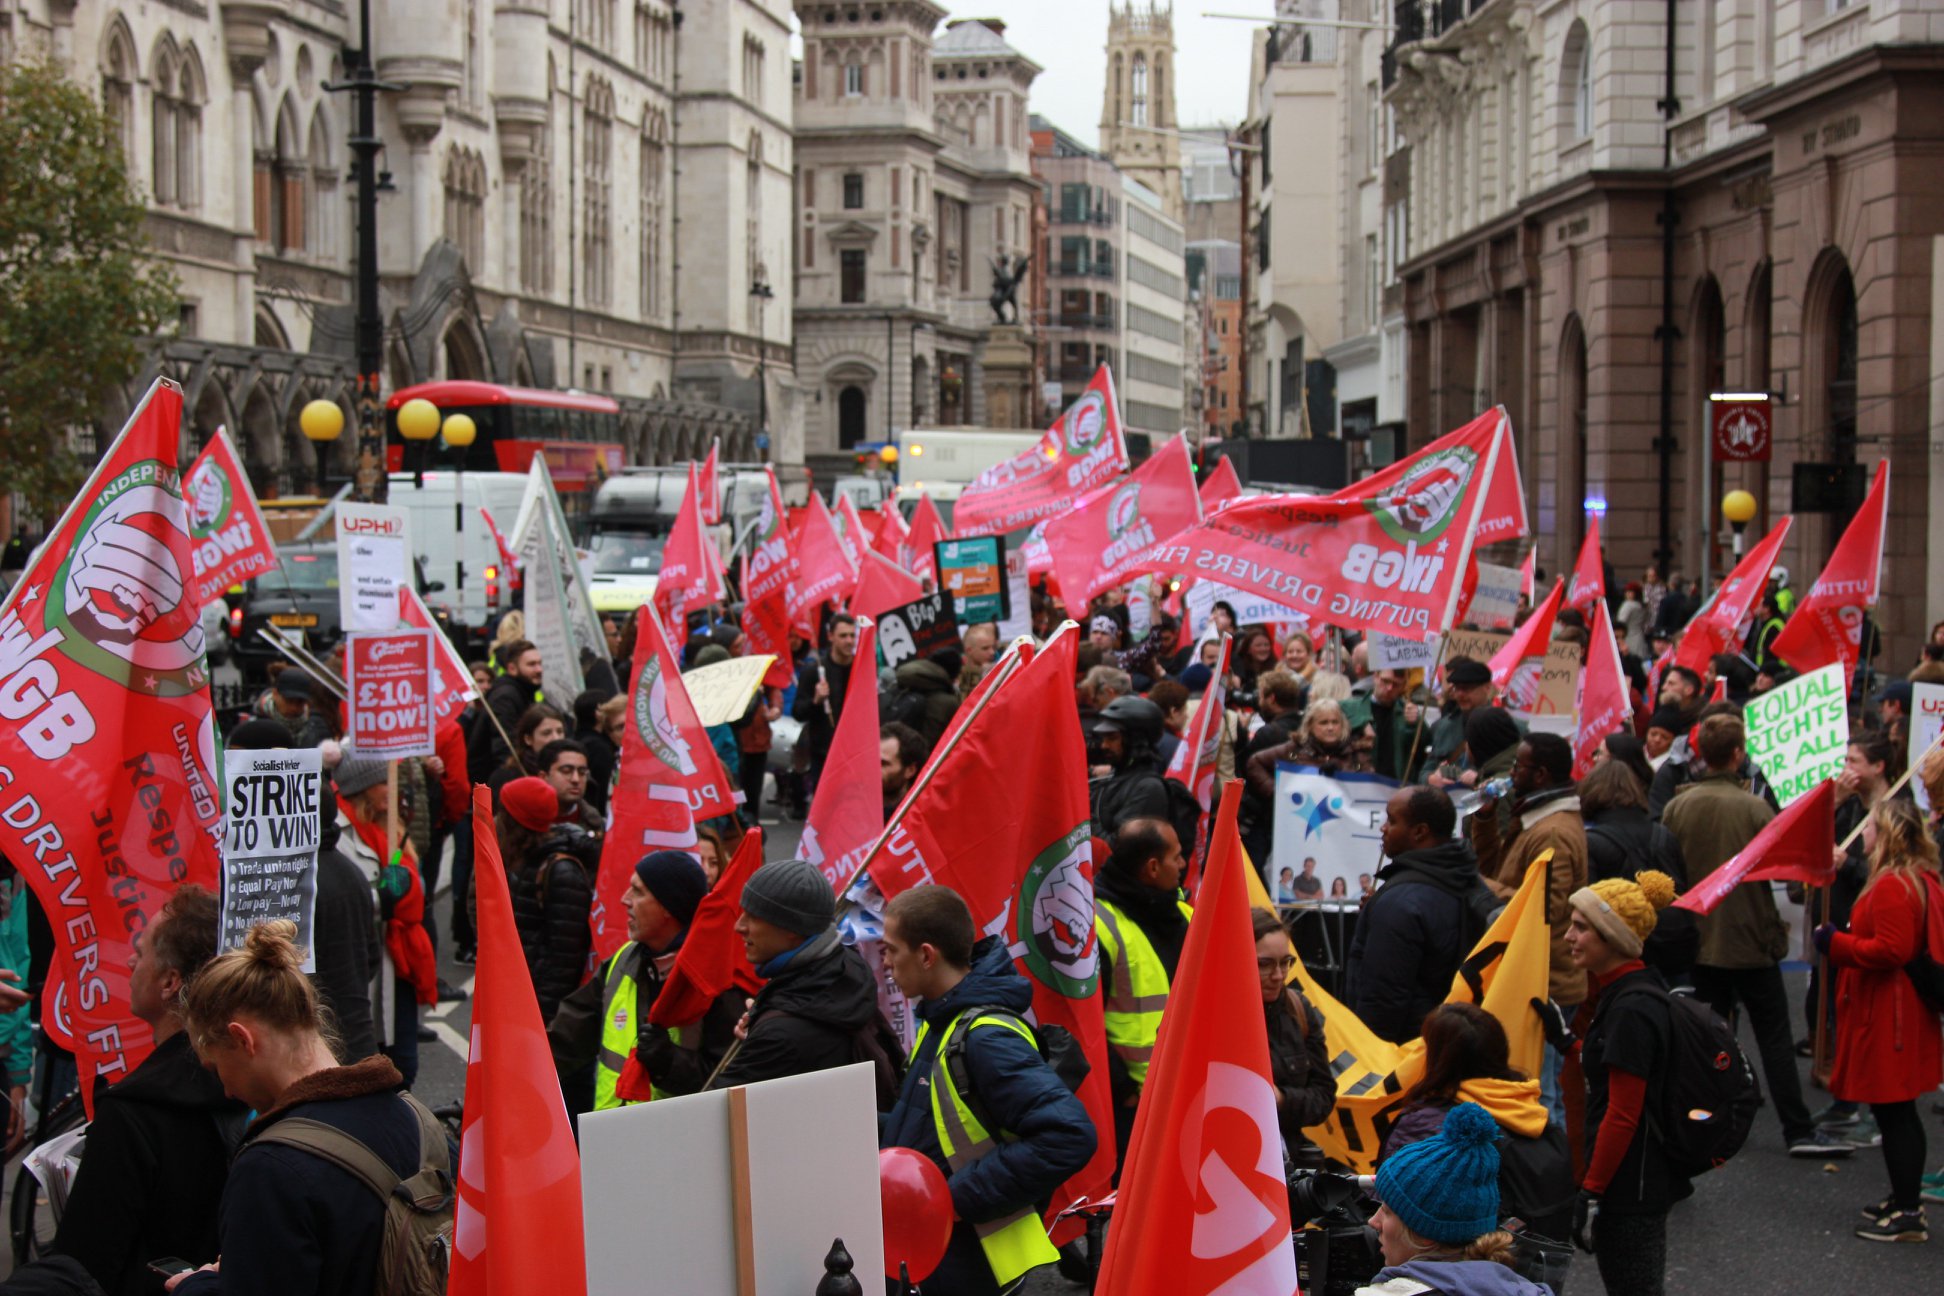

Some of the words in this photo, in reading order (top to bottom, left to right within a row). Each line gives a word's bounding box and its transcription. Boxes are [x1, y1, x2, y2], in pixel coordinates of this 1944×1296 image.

[357, 703, 427, 732] now!
[1746, 673, 1843, 731] EQUAL
[1746, 697, 1844, 757] RIGHTS
[1795, 730, 1844, 764] ALL
[172, 721, 217, 821] UNITED
[1774, 755, 1846, 804] ORKERS
[231, 773, 318, 818] STRIKE
[231, 819, 259, 851] TO
[268, 815, 318, 849] WIN!
[238, 861, 262, 875] Trade
[264, 860, 292, 873] union
[238, 879, 262, 895] Equal
[264, 878, 282, 893] Pay
[237, 898, 253, 911] Low
[235, 916, 246, 930] No
